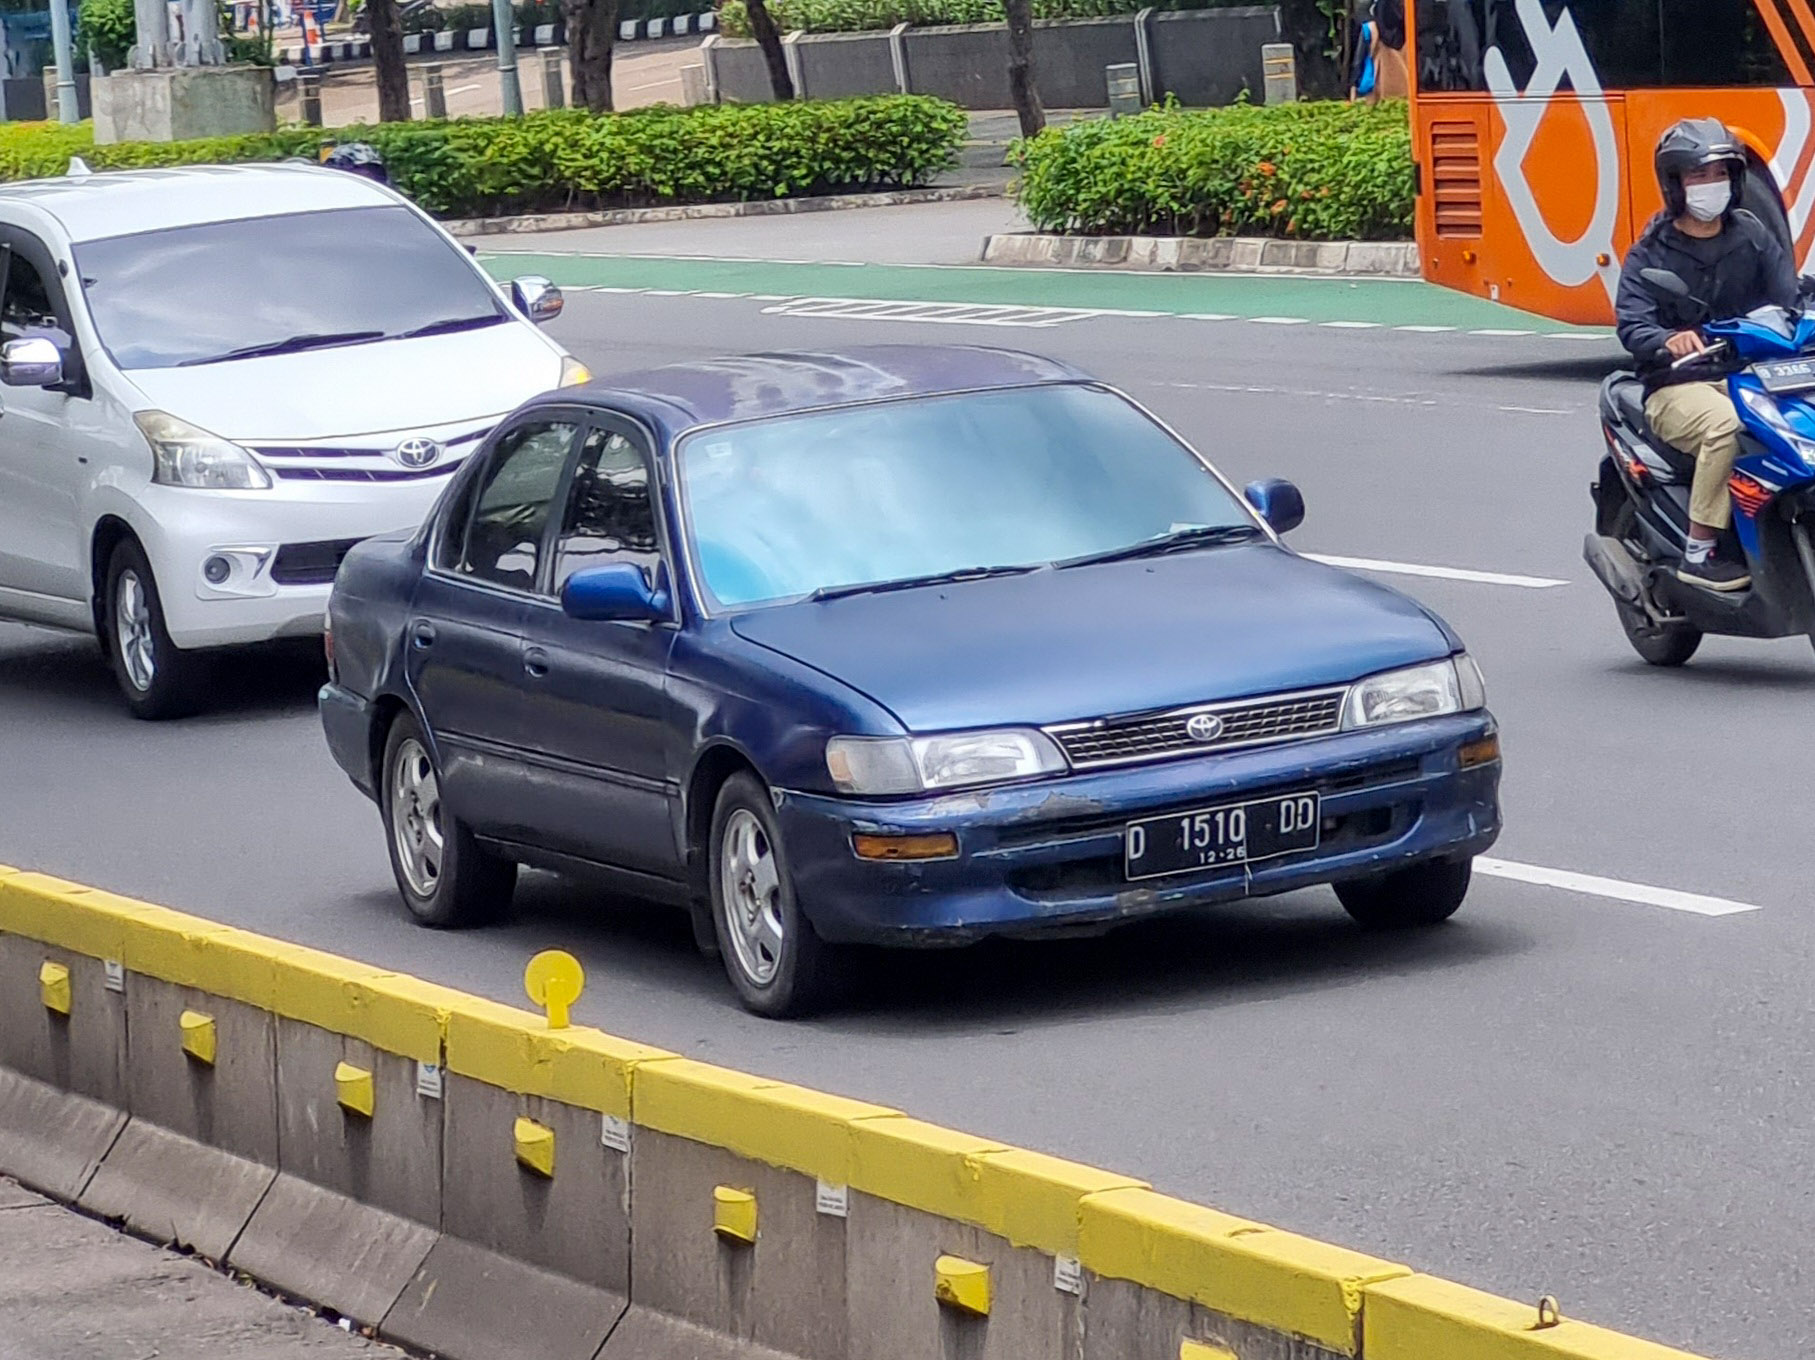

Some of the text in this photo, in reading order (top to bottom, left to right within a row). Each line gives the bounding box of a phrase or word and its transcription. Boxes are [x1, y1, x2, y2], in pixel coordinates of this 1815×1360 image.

[1128, 797, 1314, 860] D 1510 DD
